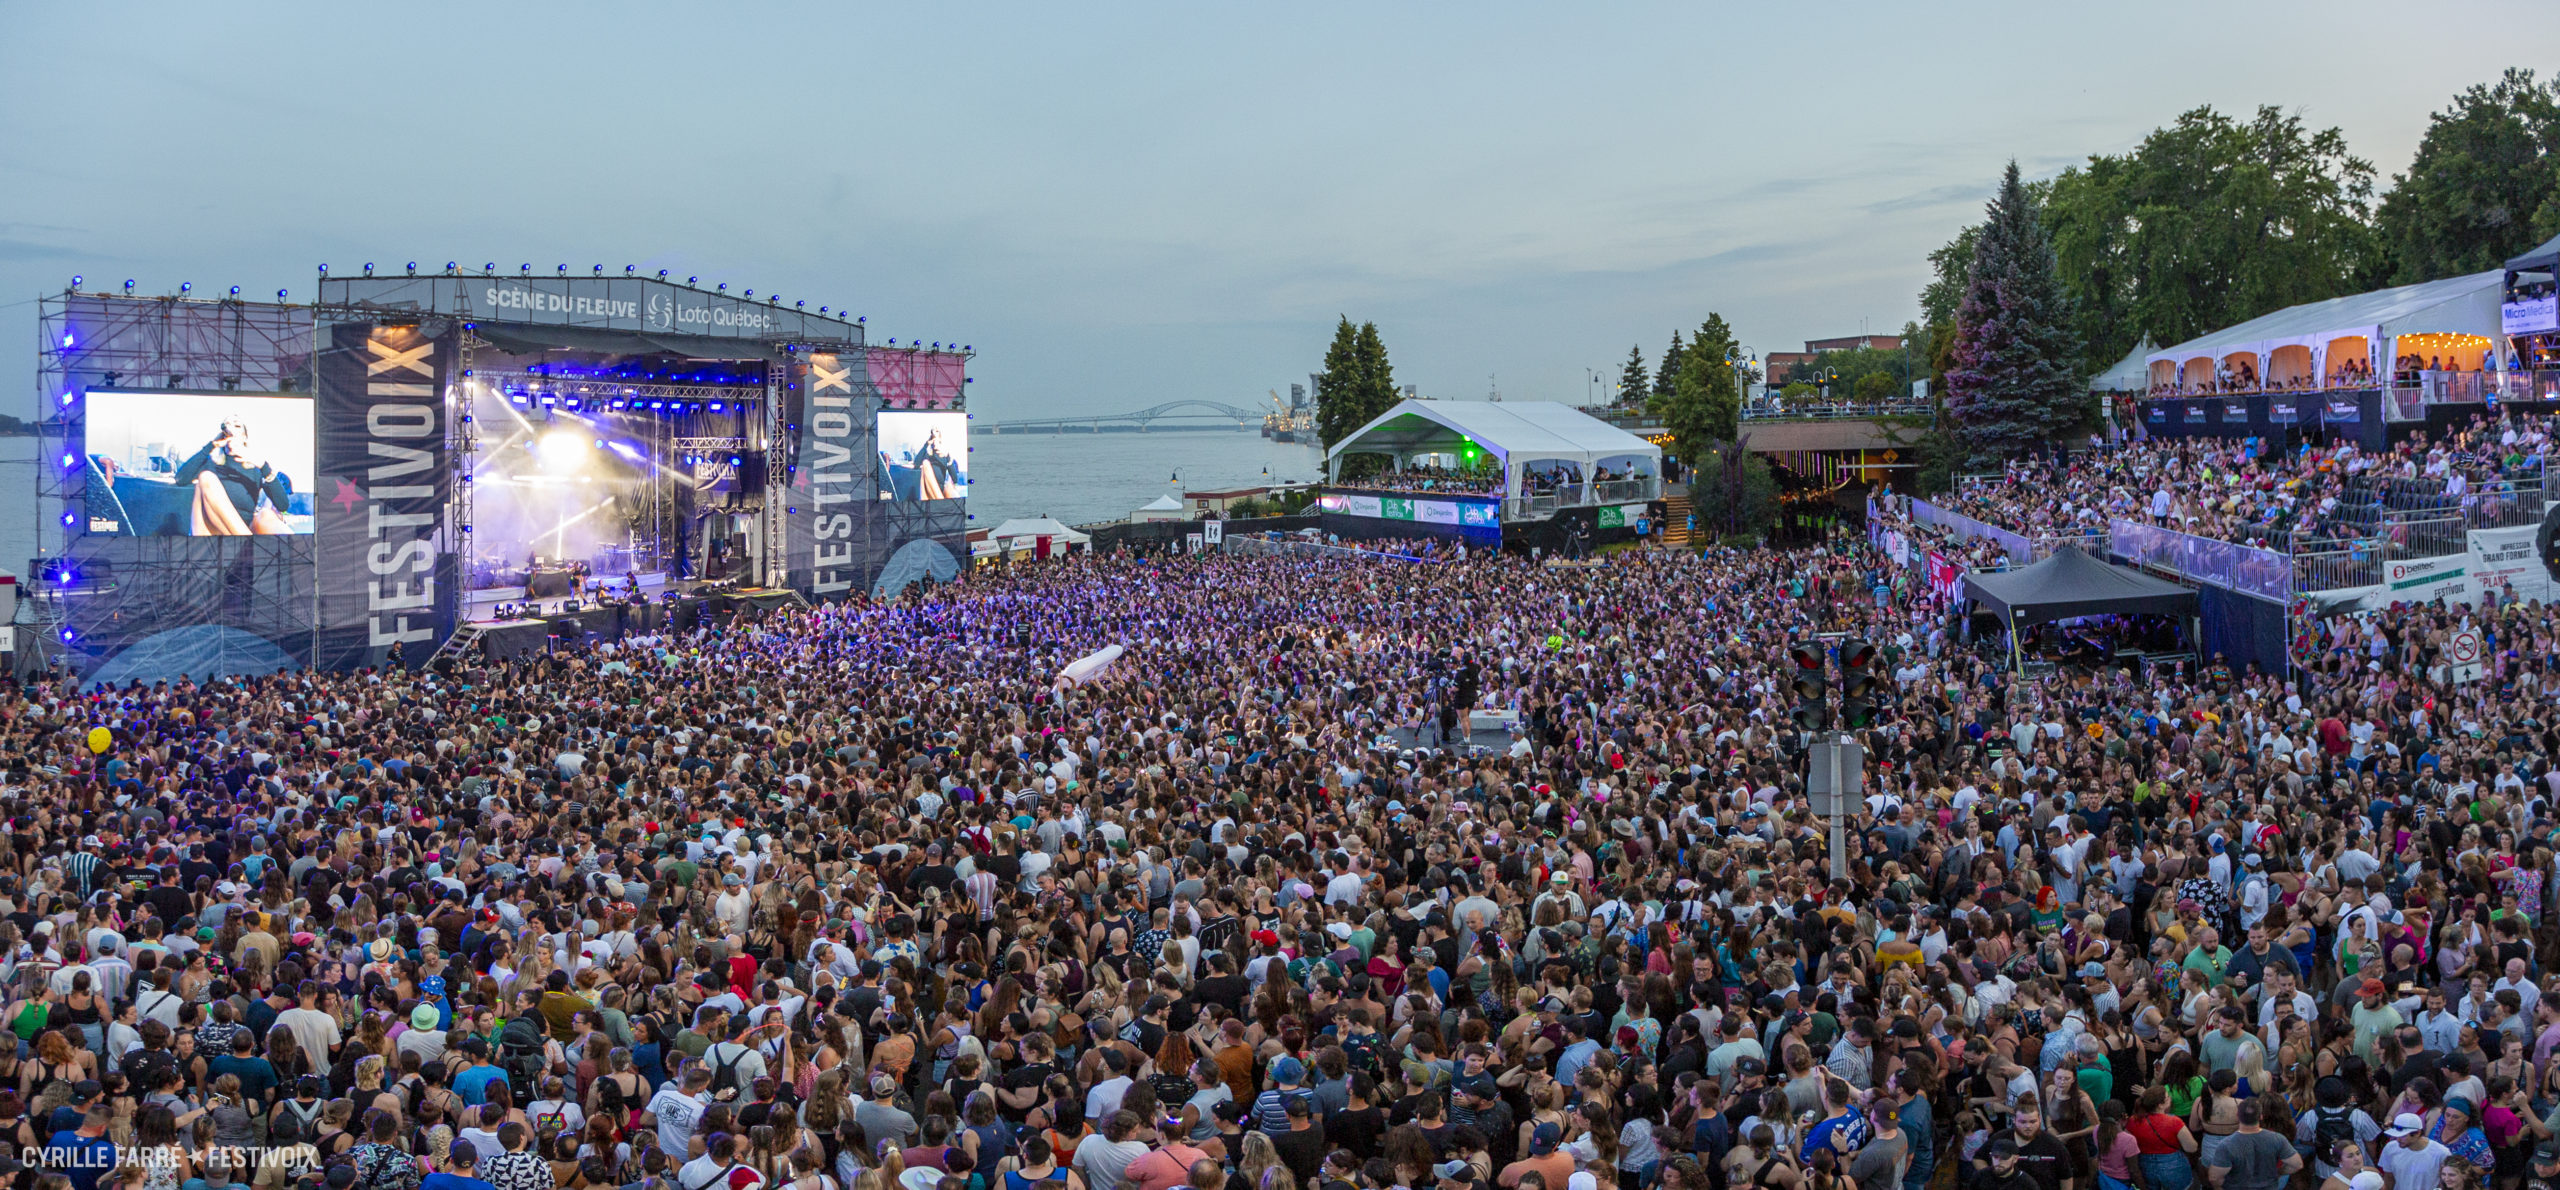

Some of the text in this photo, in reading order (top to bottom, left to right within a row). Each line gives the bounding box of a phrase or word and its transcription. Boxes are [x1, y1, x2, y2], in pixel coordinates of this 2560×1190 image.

[486, 288, 637, 318] SCÈNE DU FLEUVE
[677, 304, 770, 329] Loto Québec
[367, 338, 435, 647] FESTIVOIX
[812, 363, 852, 595] FESTIVOIX
[2483, 550, 2530, 563] GRAND FORMAT
